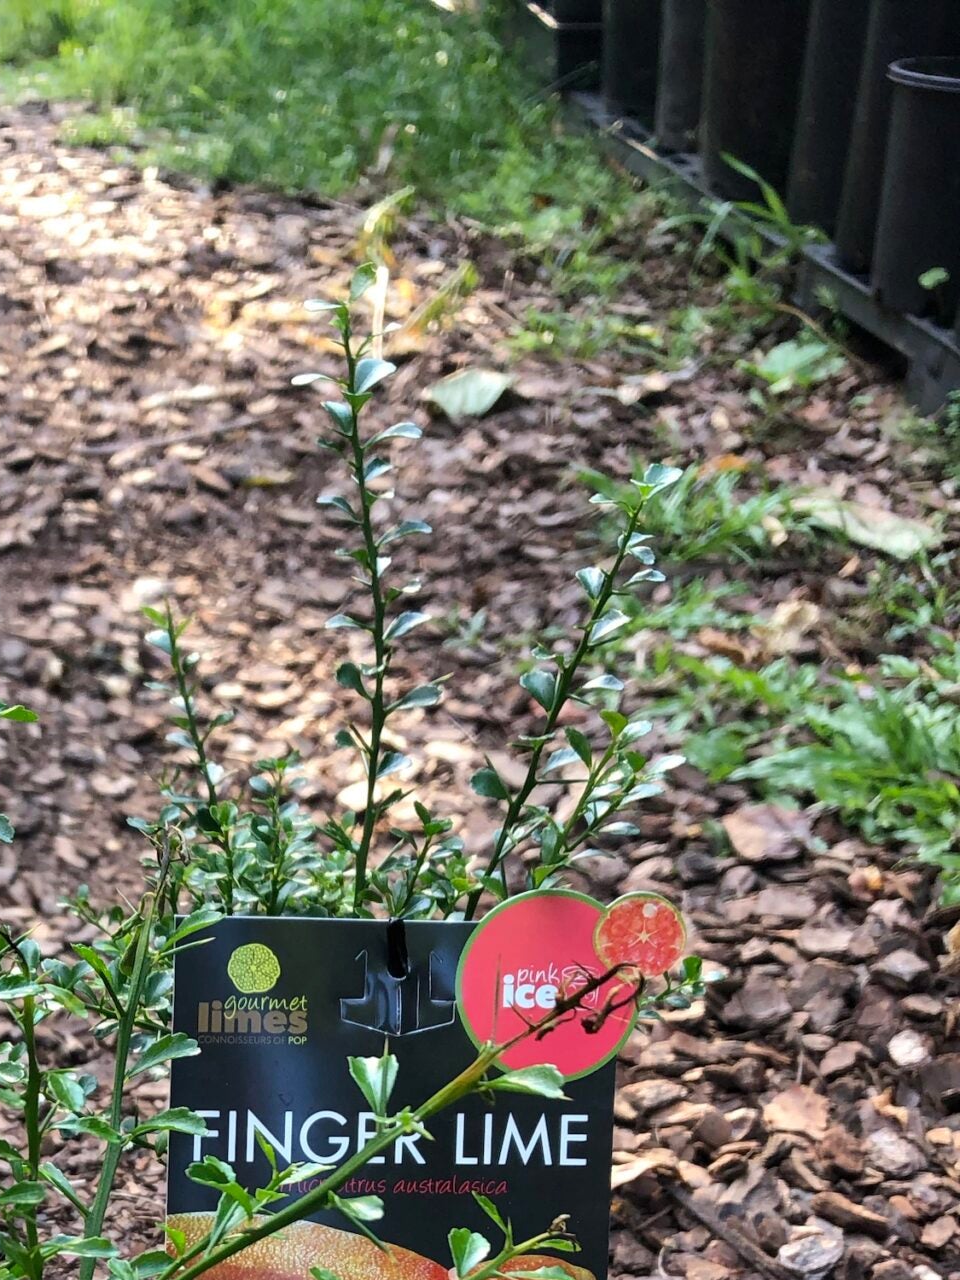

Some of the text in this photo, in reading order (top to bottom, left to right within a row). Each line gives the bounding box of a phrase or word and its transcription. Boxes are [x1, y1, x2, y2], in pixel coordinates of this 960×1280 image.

[517, 962, 560, 987] pink
[502, 974, 559, 1009] ice
[198, 1000, 308, 1034] limes
[224, 995, 308, 1019] gourmet
[198, 1035, 272, 1045] CONNOISSEURS
[288, 1035, 308, 1045] POP
[193, 1109, 589, 1166] FINGER LIME
[393, 1174, 508, 1194] australasica
